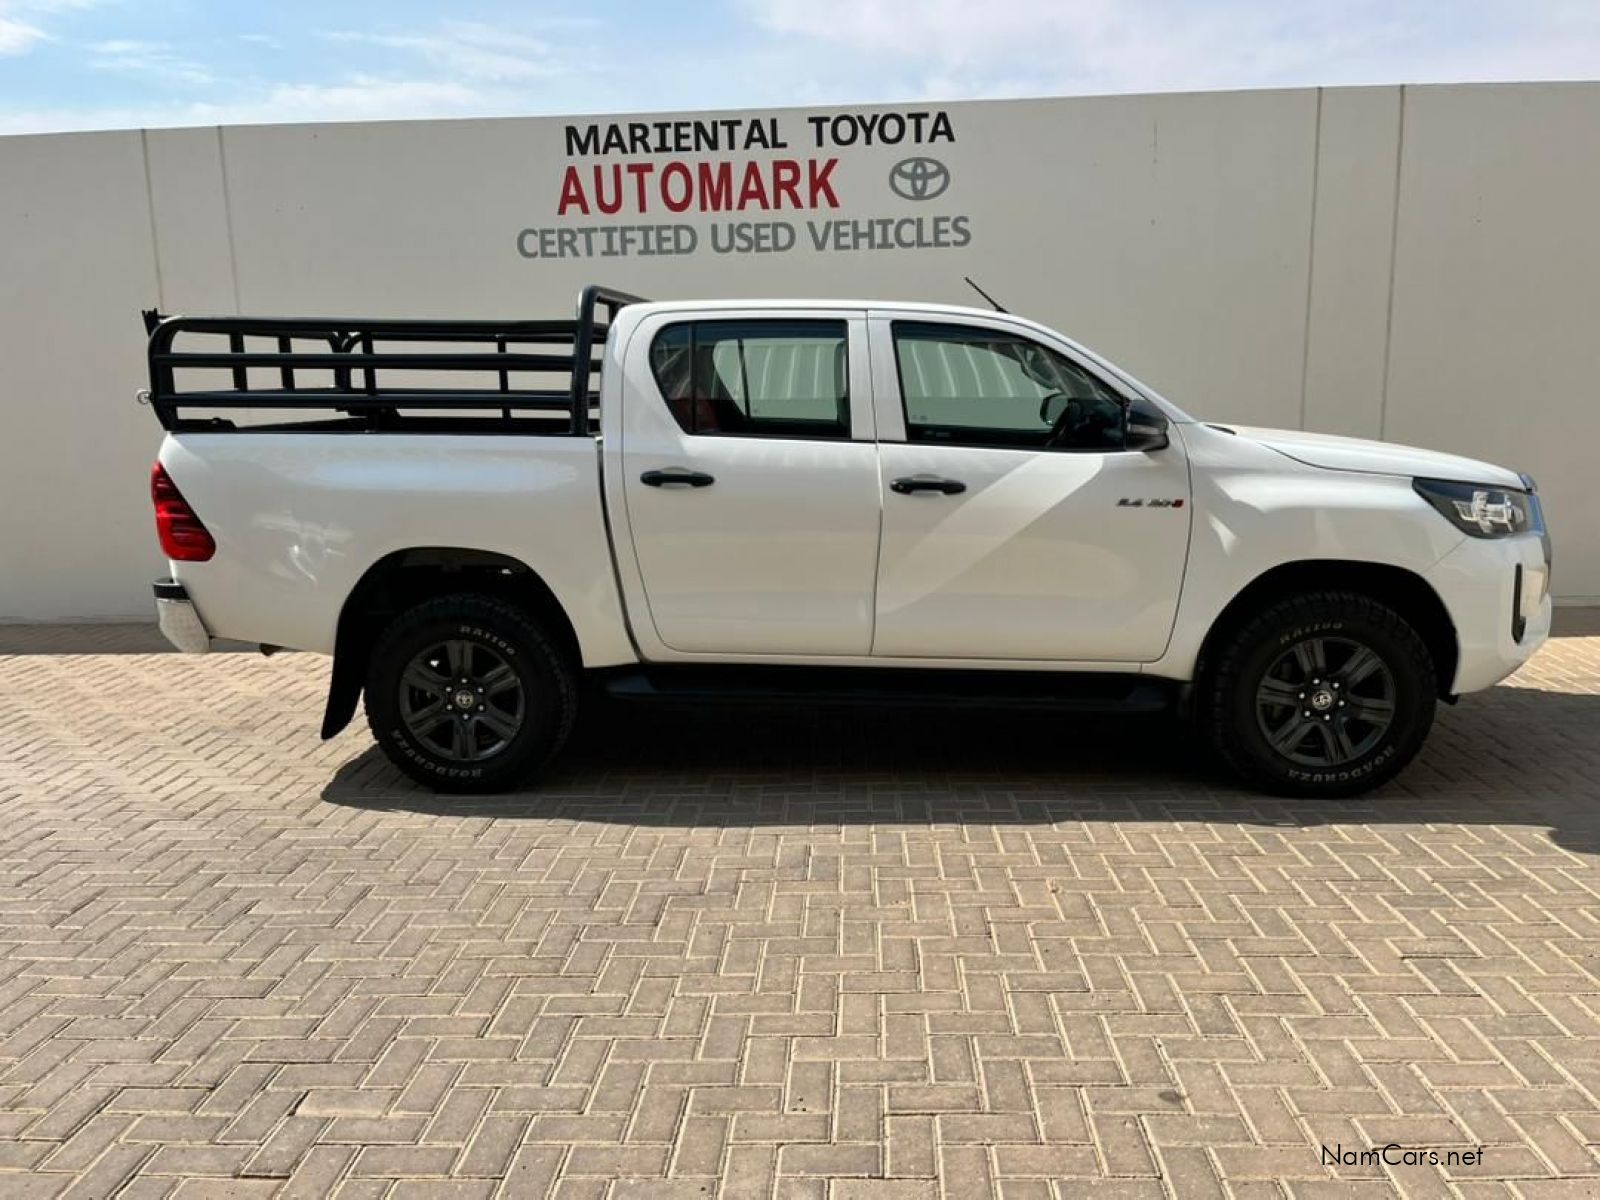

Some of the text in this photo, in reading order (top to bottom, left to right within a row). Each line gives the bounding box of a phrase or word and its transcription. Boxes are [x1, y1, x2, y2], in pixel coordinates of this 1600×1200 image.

[565, 111, 956, 156] MARIENTAL TOYOTA
[558, 159, 840, 215] AUTOMARK
[516, 215, 972, 259] CERTIFIED USED VEHICLES
